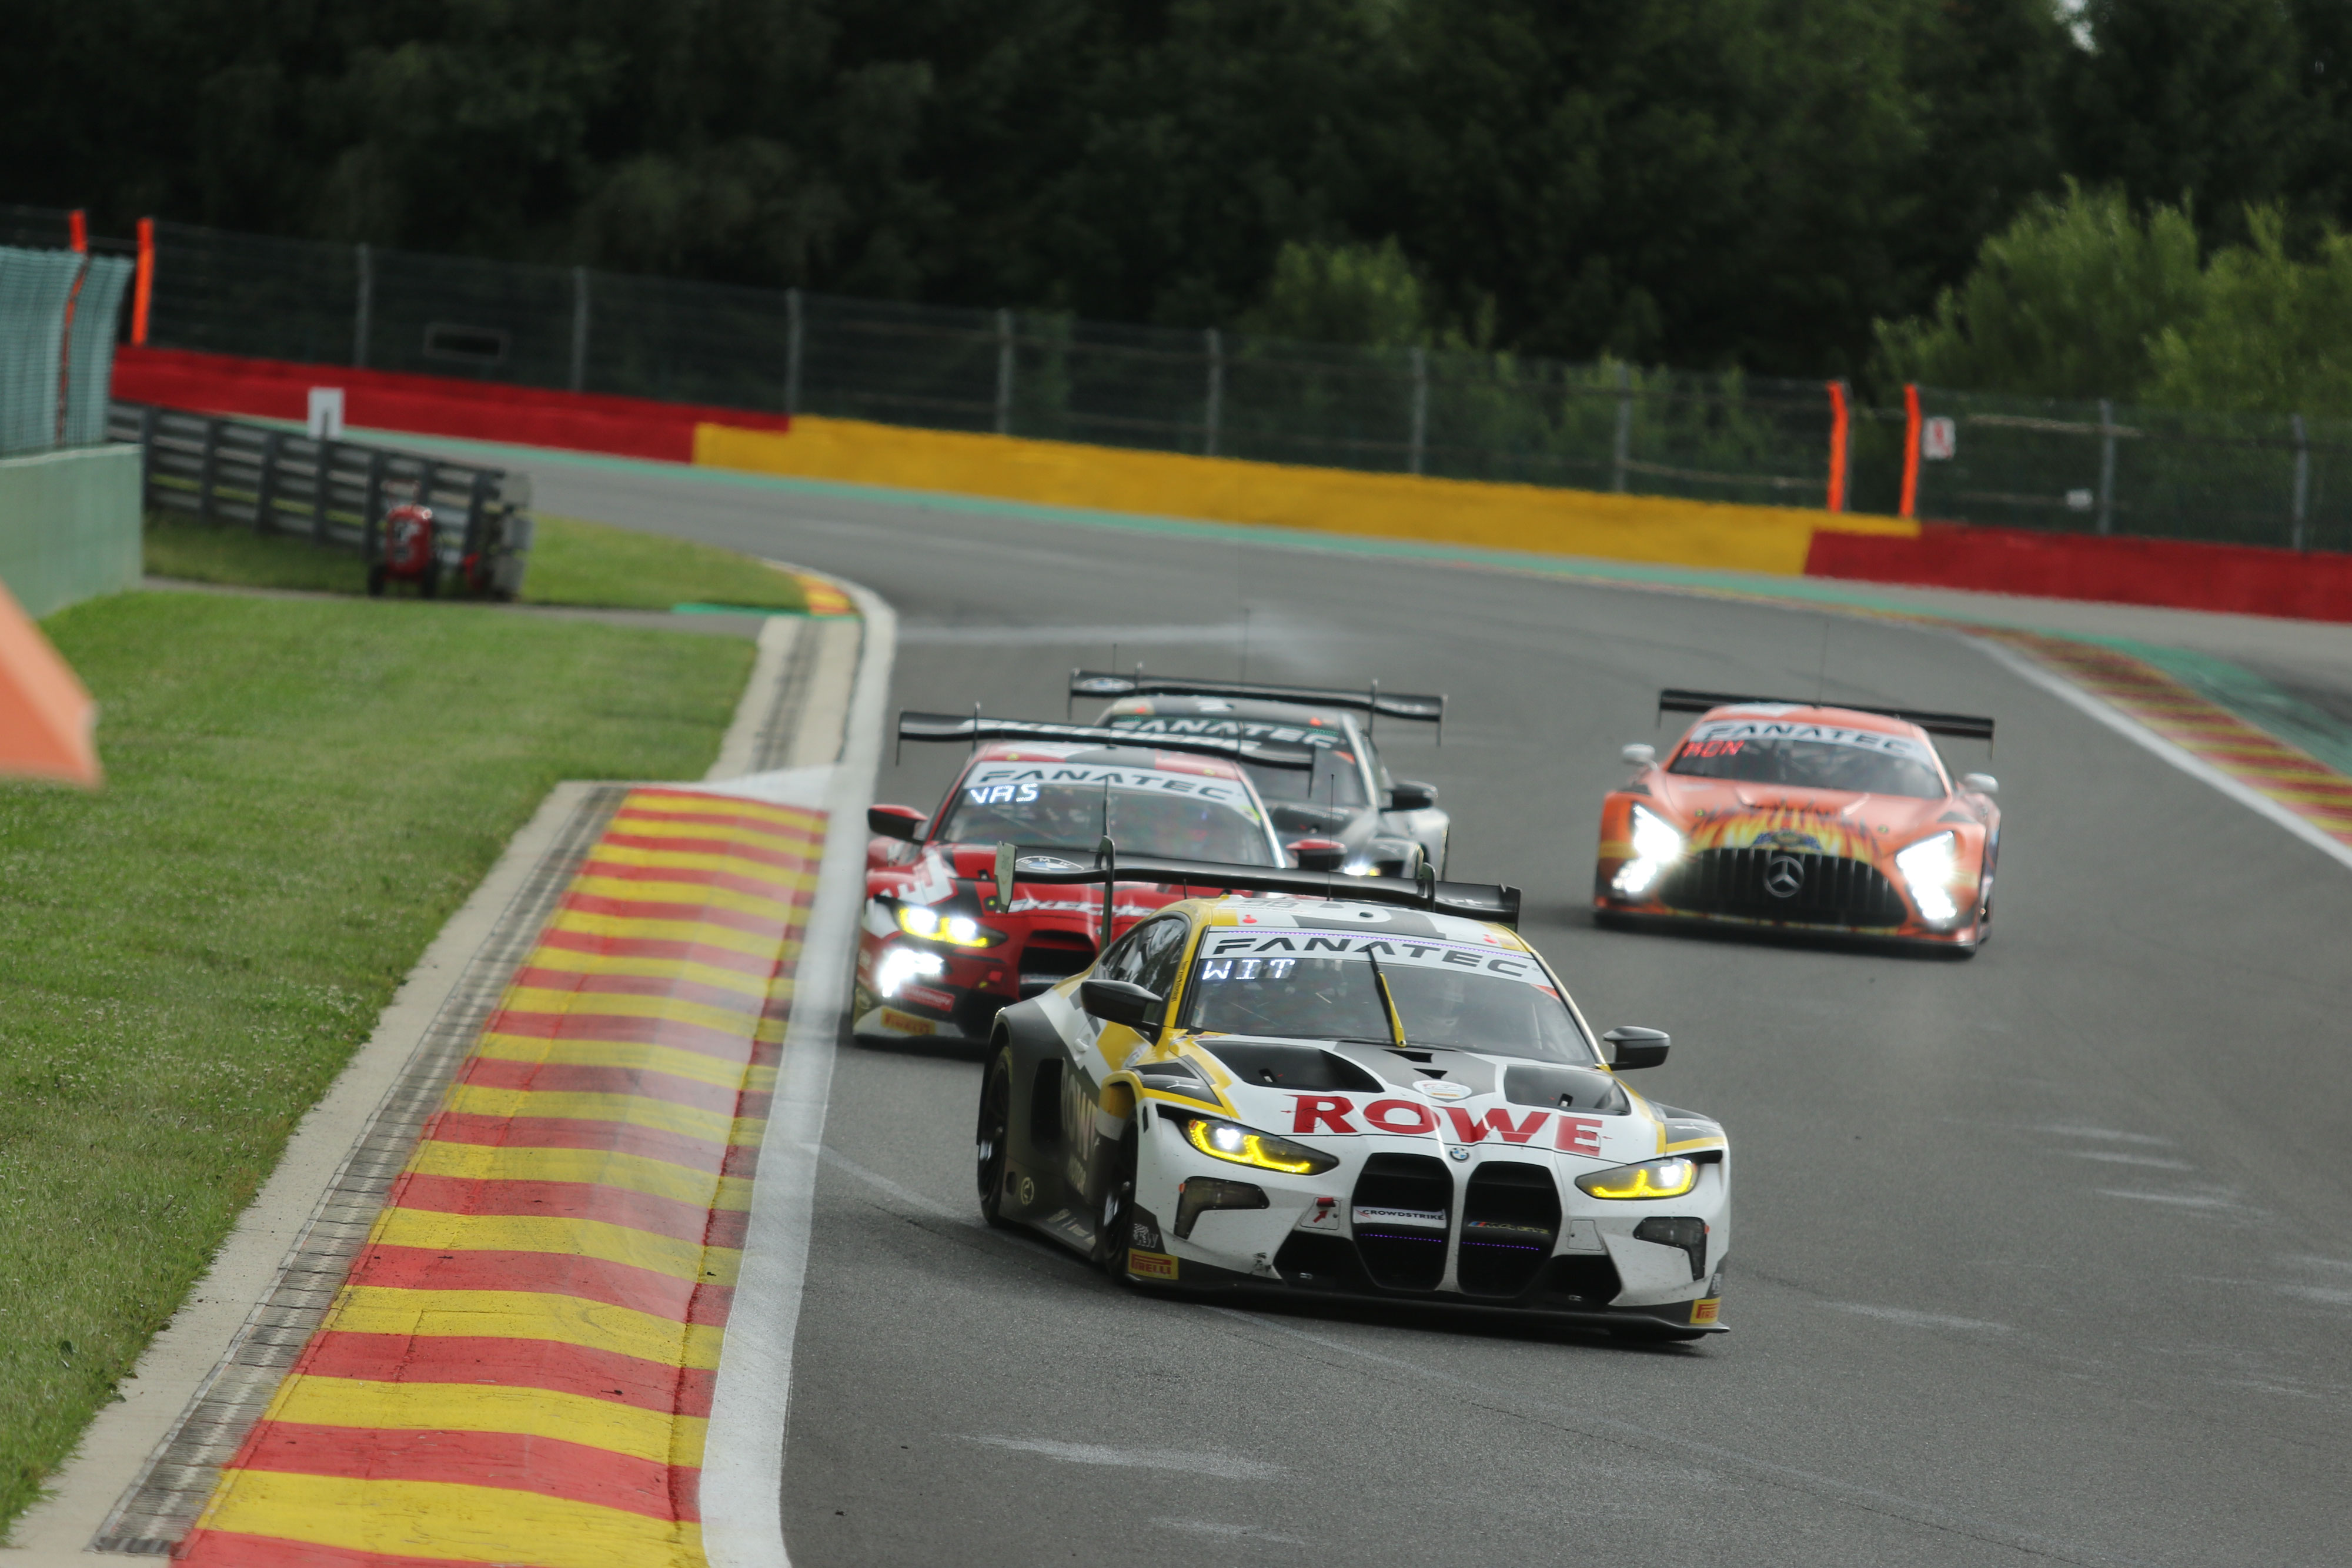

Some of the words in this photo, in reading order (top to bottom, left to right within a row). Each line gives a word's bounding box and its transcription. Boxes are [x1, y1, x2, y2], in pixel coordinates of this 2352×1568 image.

[1111, 718, 1339, 748] FANATEC
[1705, 724, 1912, 755] FANATEC
[970, 783, 1039, 804] VAS
[981, 770, 1234, 800] FANATEC
[1239, 900, 1299, 908] 98
[1202, 958, 1295, 980] WIT
[1213, 937, 1528, 977] FANATEC
[1283, 1094, 1603, 1157] ROWE
[1362, 1209, 1444, 1221] CROWDSTRIKE
[1131, 1253, 1171, 1275] PIRELLI
